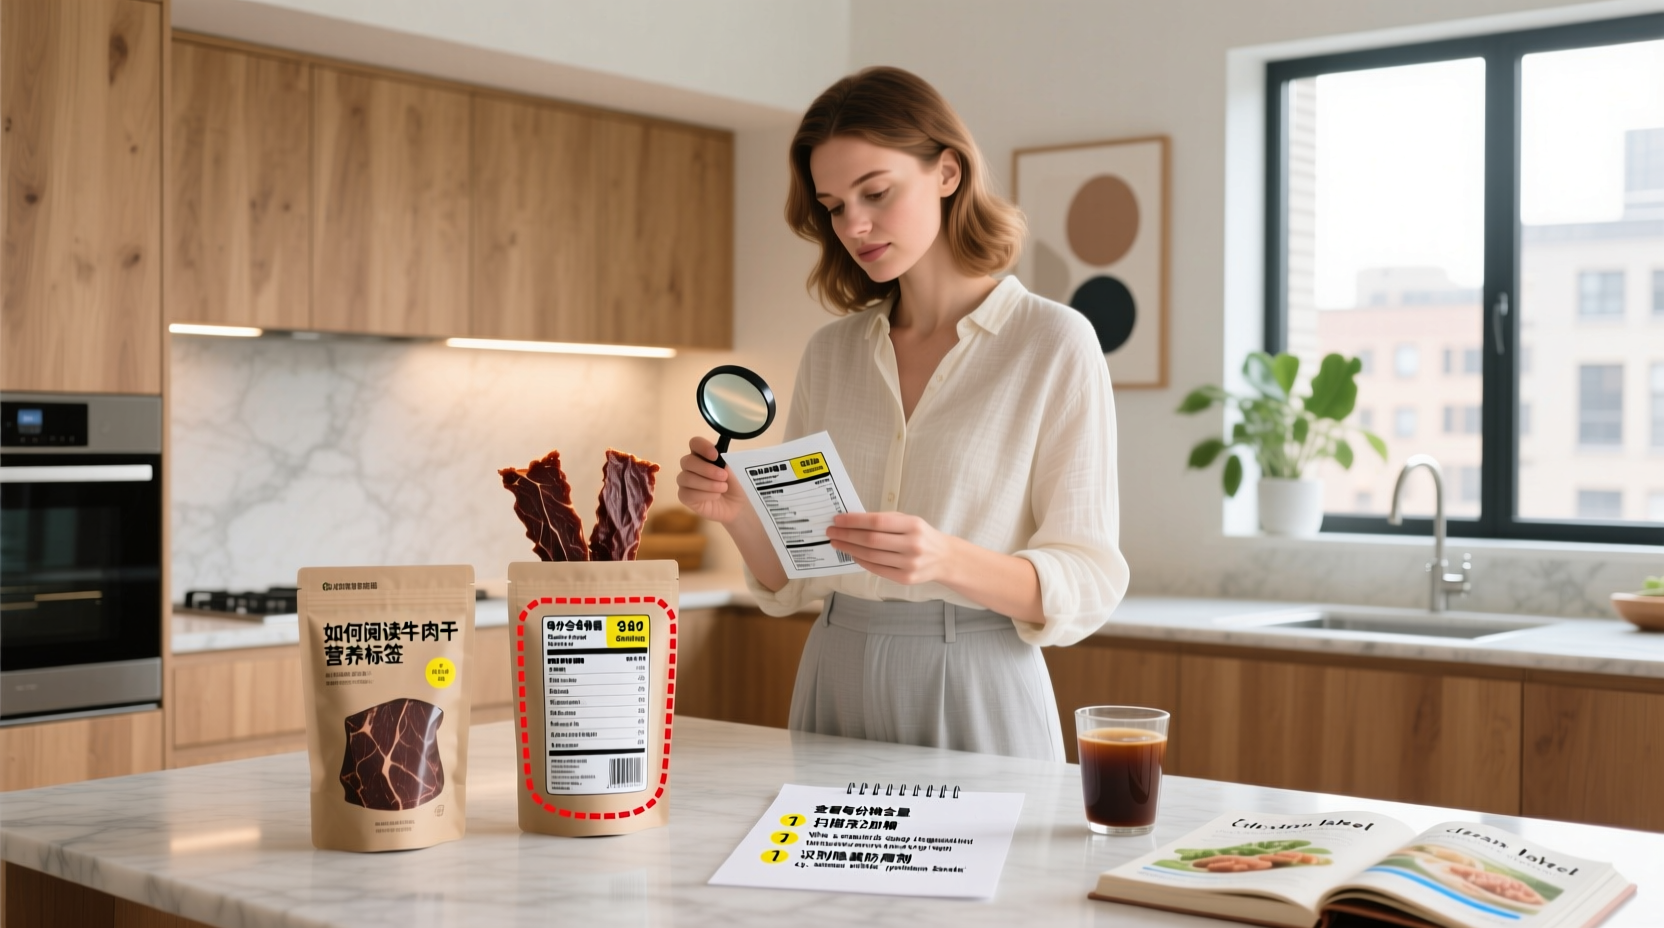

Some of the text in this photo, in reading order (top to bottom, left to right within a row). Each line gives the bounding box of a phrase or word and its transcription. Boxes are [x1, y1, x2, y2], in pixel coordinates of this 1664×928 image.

[324, 621, 459, 643] 如何阅读牛肉干
[324, 643, 403, 666] 营养标签
